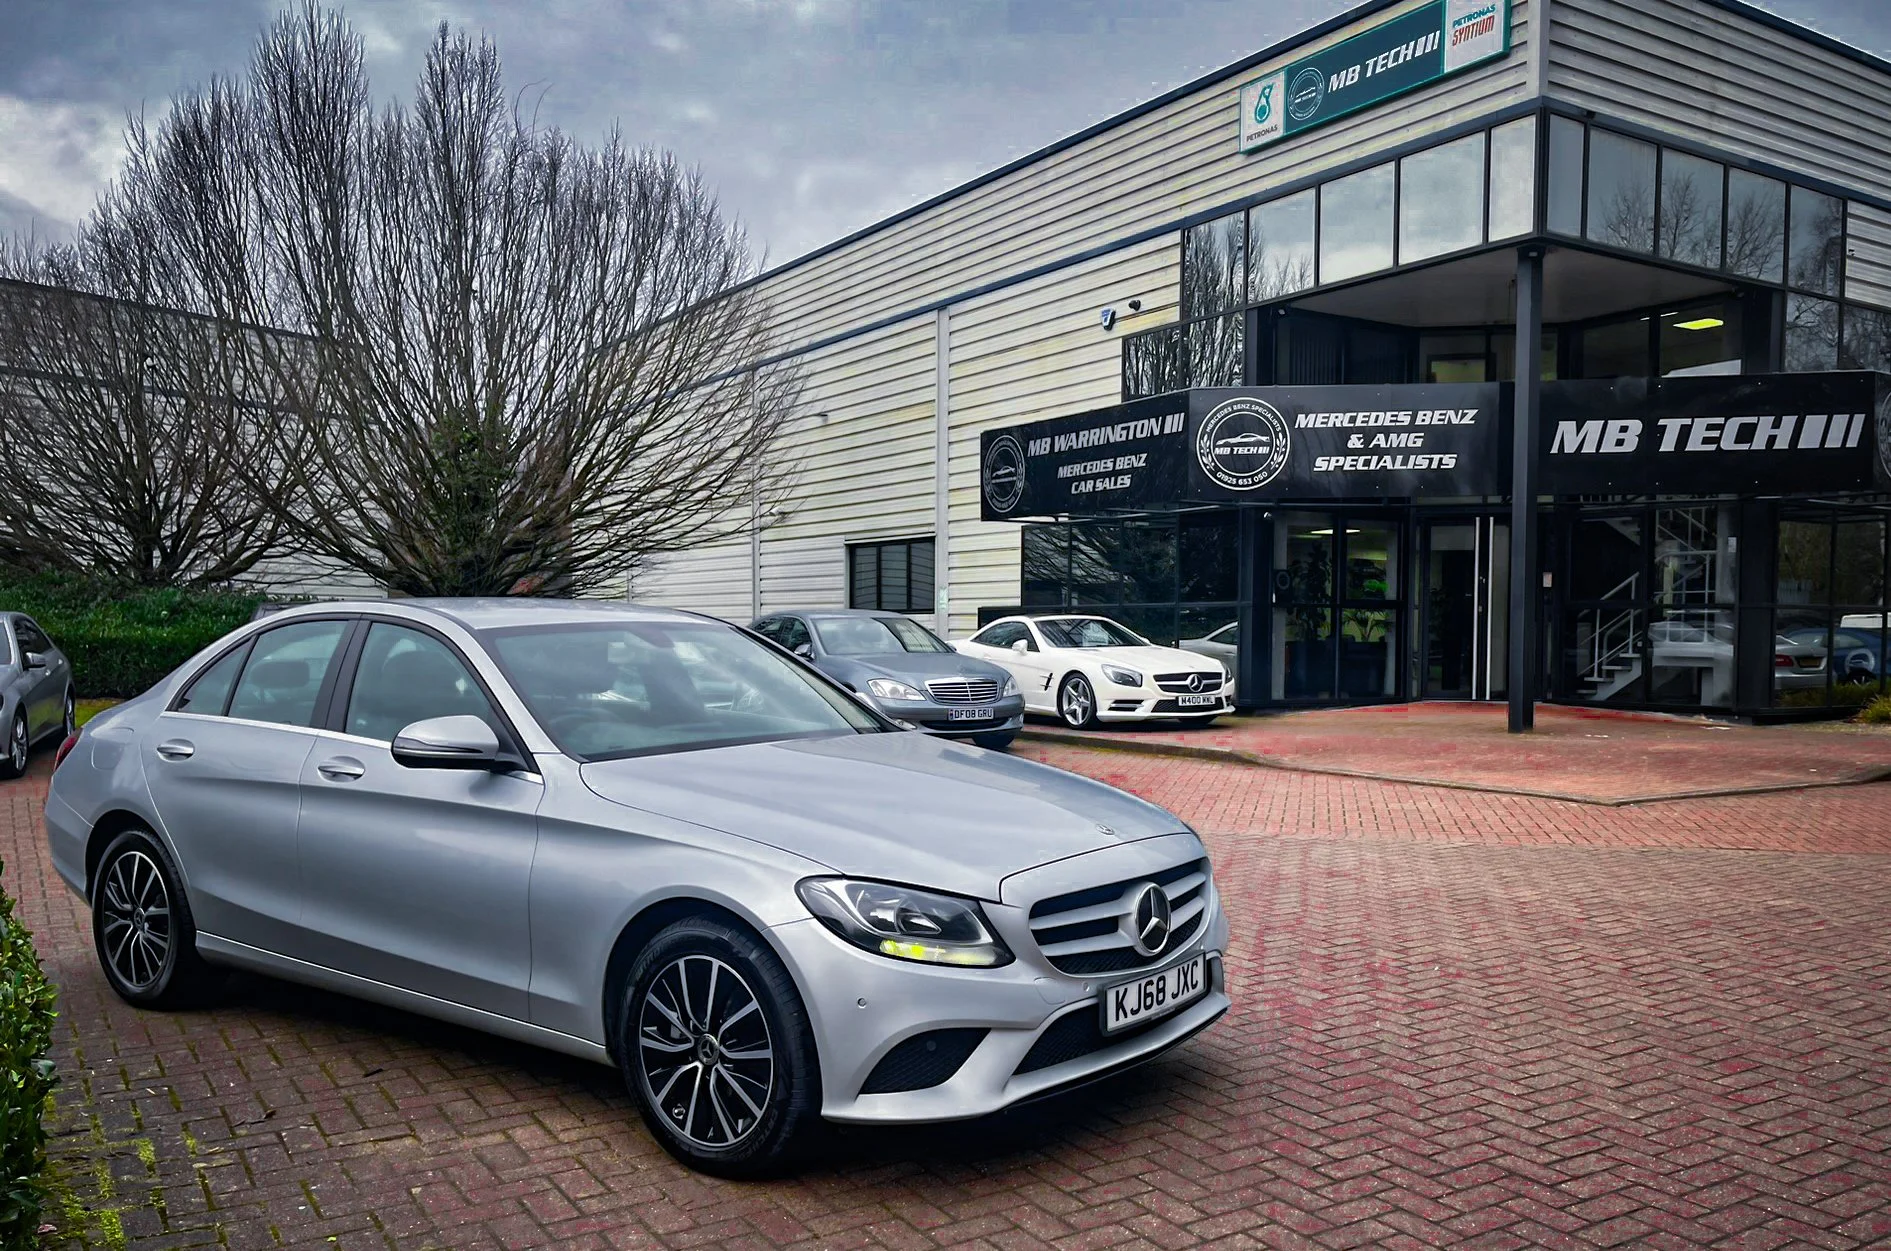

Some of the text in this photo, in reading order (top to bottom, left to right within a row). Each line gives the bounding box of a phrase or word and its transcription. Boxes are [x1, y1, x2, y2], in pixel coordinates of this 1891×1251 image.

[1452, 4, 1496, 28] PETRONAS
[1452, 15, 1495, 46] SYNTIUM
[1328, 65, 1360, 93] MB
[1246, 124, 1278, 142] PETRONAS
[1206, 406, 1232, 433] MERCEDES
[1251, 404, 1282, 432] SPECIALISTS
[1295, 409, 1479, 428] MERCEDES BENZ
[1027, 435, 1051, 457] MB
[1054, 416, 1162, 453] WARRINGTON
[1347, 433, 1425, 449] & AMG
[1550, 419, 1643, 454] MB
[1057, 453, 1148, 479] MERCEDES BENZ
[1313, 454, 1457, 472] SPECIALISTS
[1071, 475, 1132, 495] CAR SALES
[1216, 471, 1237, 485] 01925
[1253, 471, 1268, 482] 050
[955, 709, 993, 719] DF08 GRU
[1115, 959, 1199, 1022] KJ68 JXC
